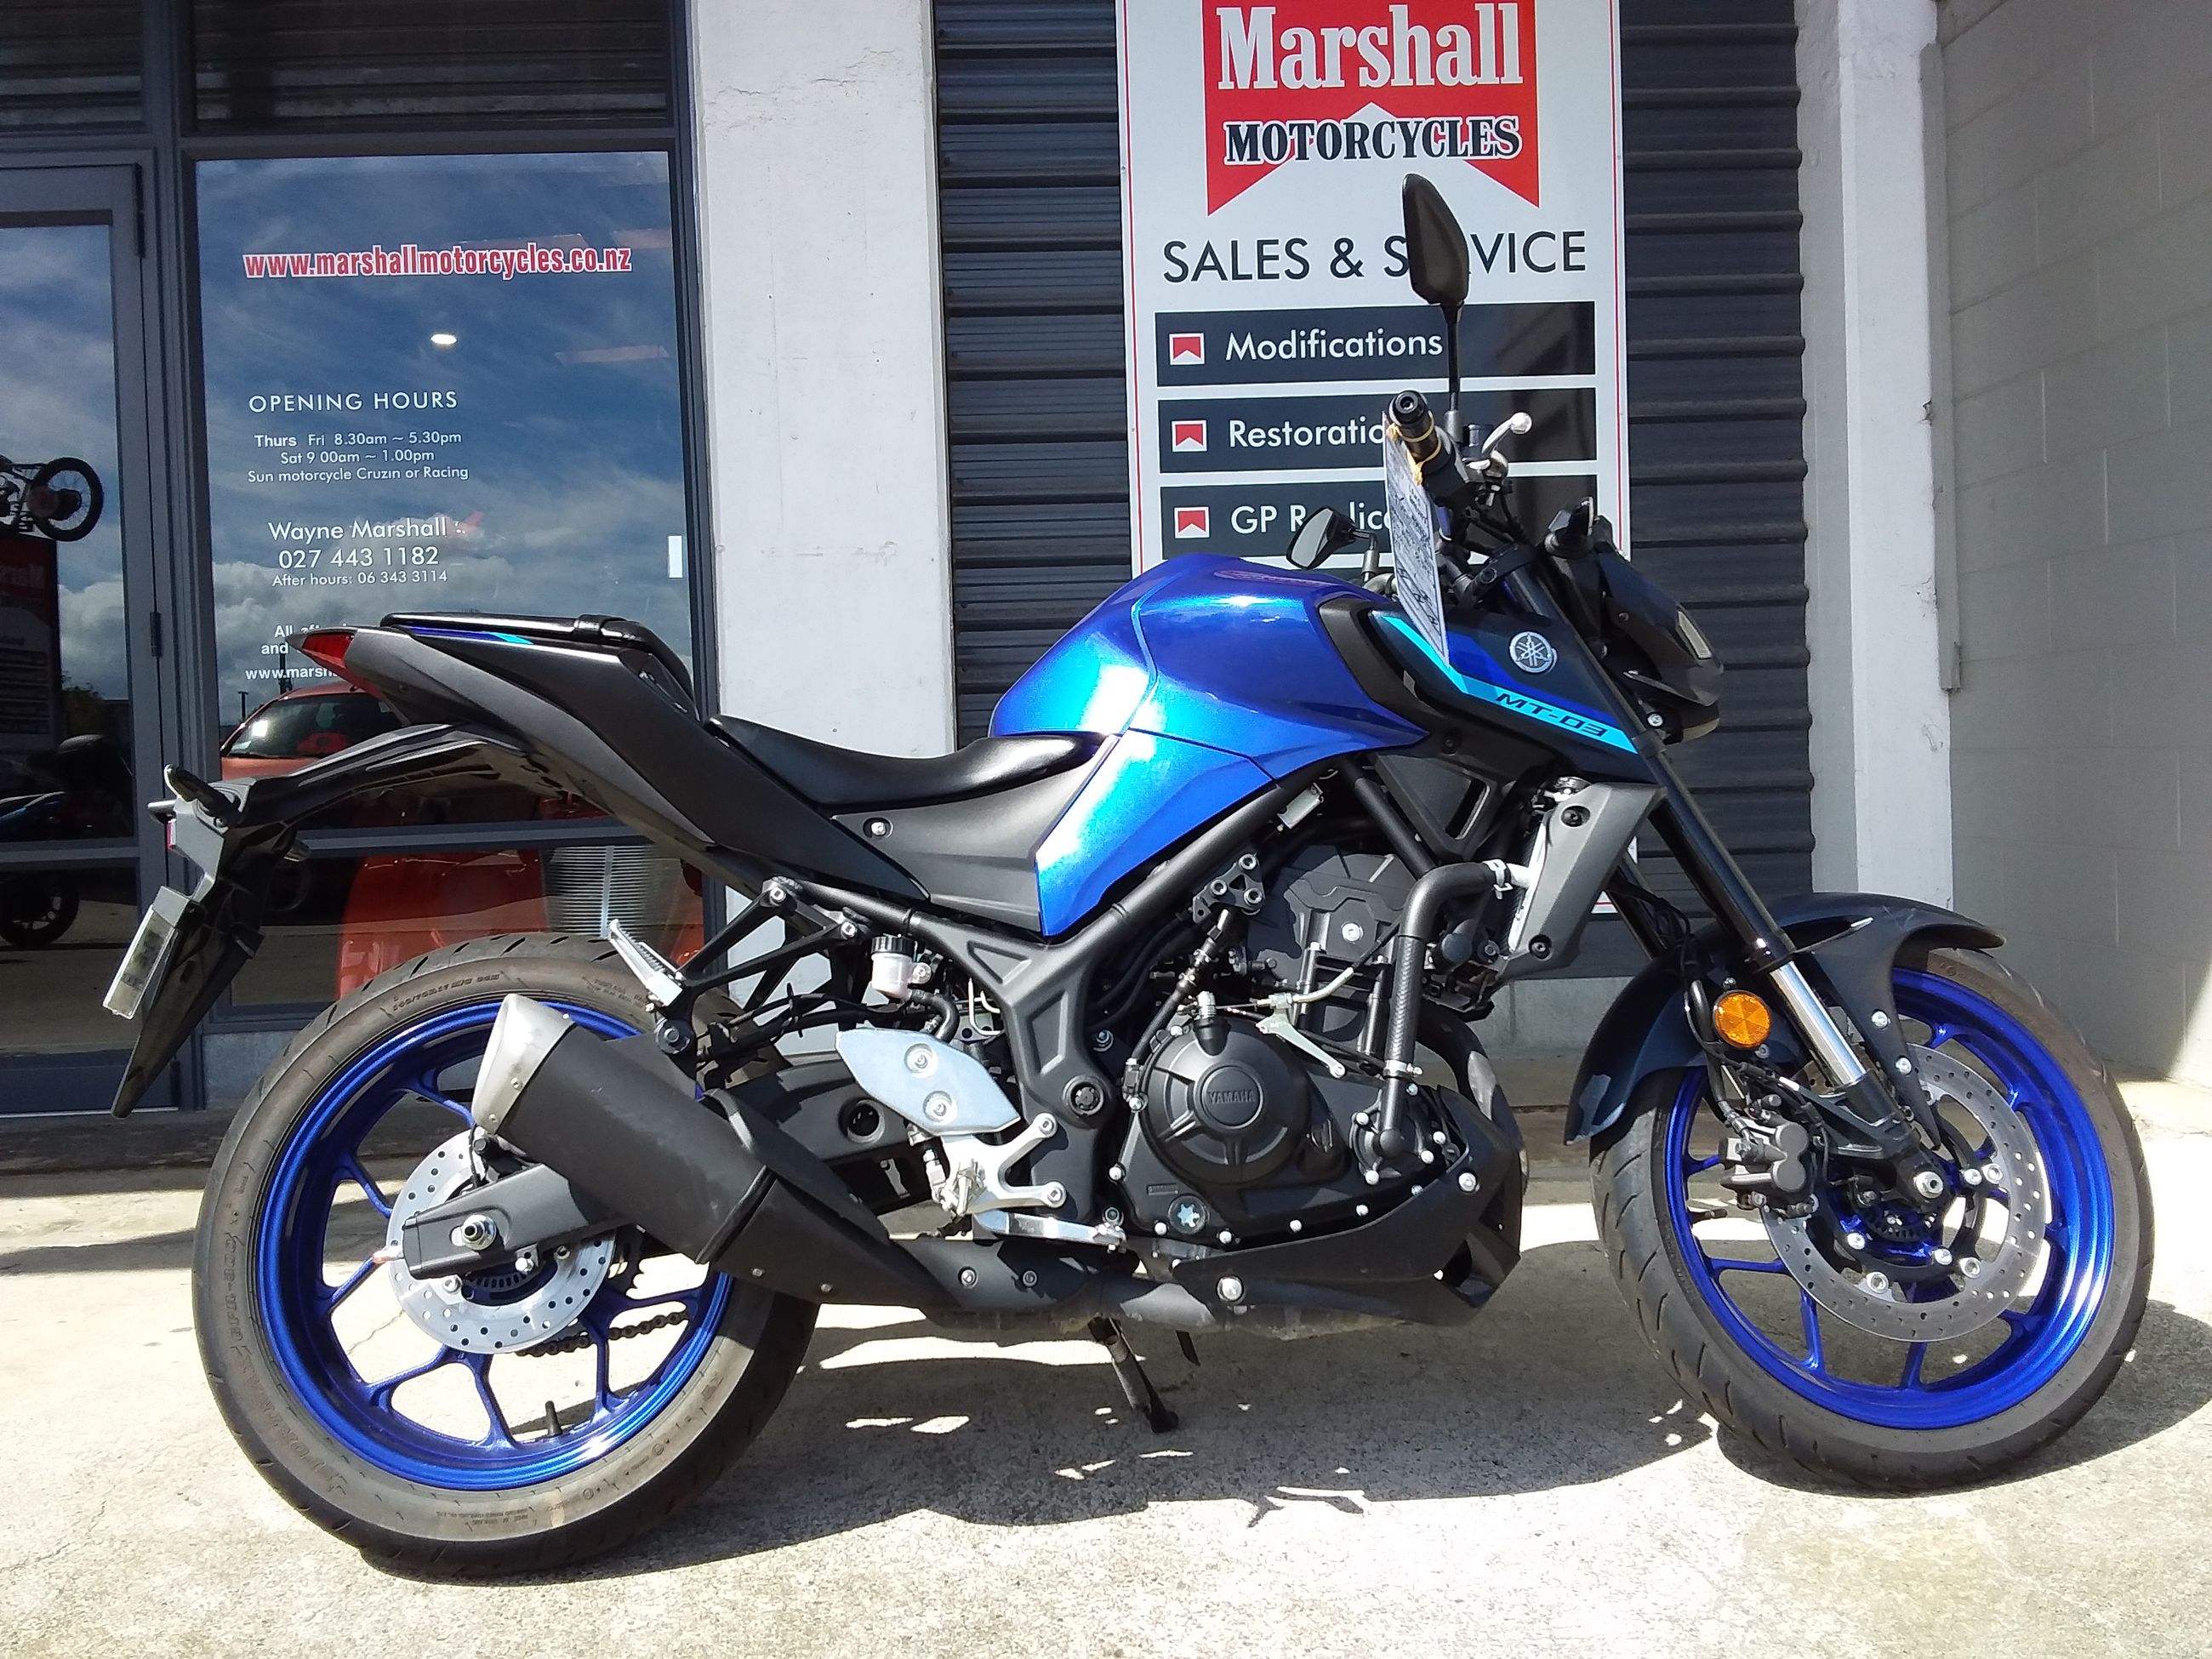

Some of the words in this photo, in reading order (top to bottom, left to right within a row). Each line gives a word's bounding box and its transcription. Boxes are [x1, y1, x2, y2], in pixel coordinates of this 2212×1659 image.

[1216, 3, 1524, 89] Marshall
[1223, 116, 1521, 164] MOTORCYCLES
[242, 242, 632, 280] www.marshallmotorcycles.co.nz
[1163, 239, 1310, 282] SALES
[1331, 237, 1364, 278] &
[1383, 231, 1587, 277] SVICE
[1224, 328, 1444, 362] Modifications
[248, 393, 362, 413] OPENING
[373, 391, 458, 410] HOURS
[254, 434, 297, 448] Thurs
[307, 433, 325, 447] Fri
[334, 432, 387, 446] 8.30am
[408, 431, 462, 447] 5.30pm
[1229, 415, 1386, 448] Restoratio
[281, 452, 303, 464] Sat
[382, 449, 435, 465] 1.00pm
[248, 470, 274, 483] Sun
[278, 468, 352, 483] motorcycle
[356, 468, 401, 480] Cruzin
[405, 469, 419, 478] or
[424, 466, 469, 481] Racing
[1231, 505, 1277, 534] GP
[1290, 501, 1392, 533] Rlic
[268, 522, 344, 544] Wayne
[351, 516, 447, 539] Marshall
[278, 549, 322, 569] 027
[330, 547, 373, 567] 443
[384, 546, 439, 566] 1182
[272, 573, 306, 587] After
[311, 573, 353, 585] hours:
[357, 572, 375, 584] 06
[380, 571, 407, 583] 343
[412, 570, 448, 583] 3114
[274, 624, 294, 638] All
[261, 642, 289, 655] and
[245, 667, 338, 680] www.marsh
[1496, 693, 1608, 738] MT-03
[1207, 1089, 1256, 1105] YAMAHA
